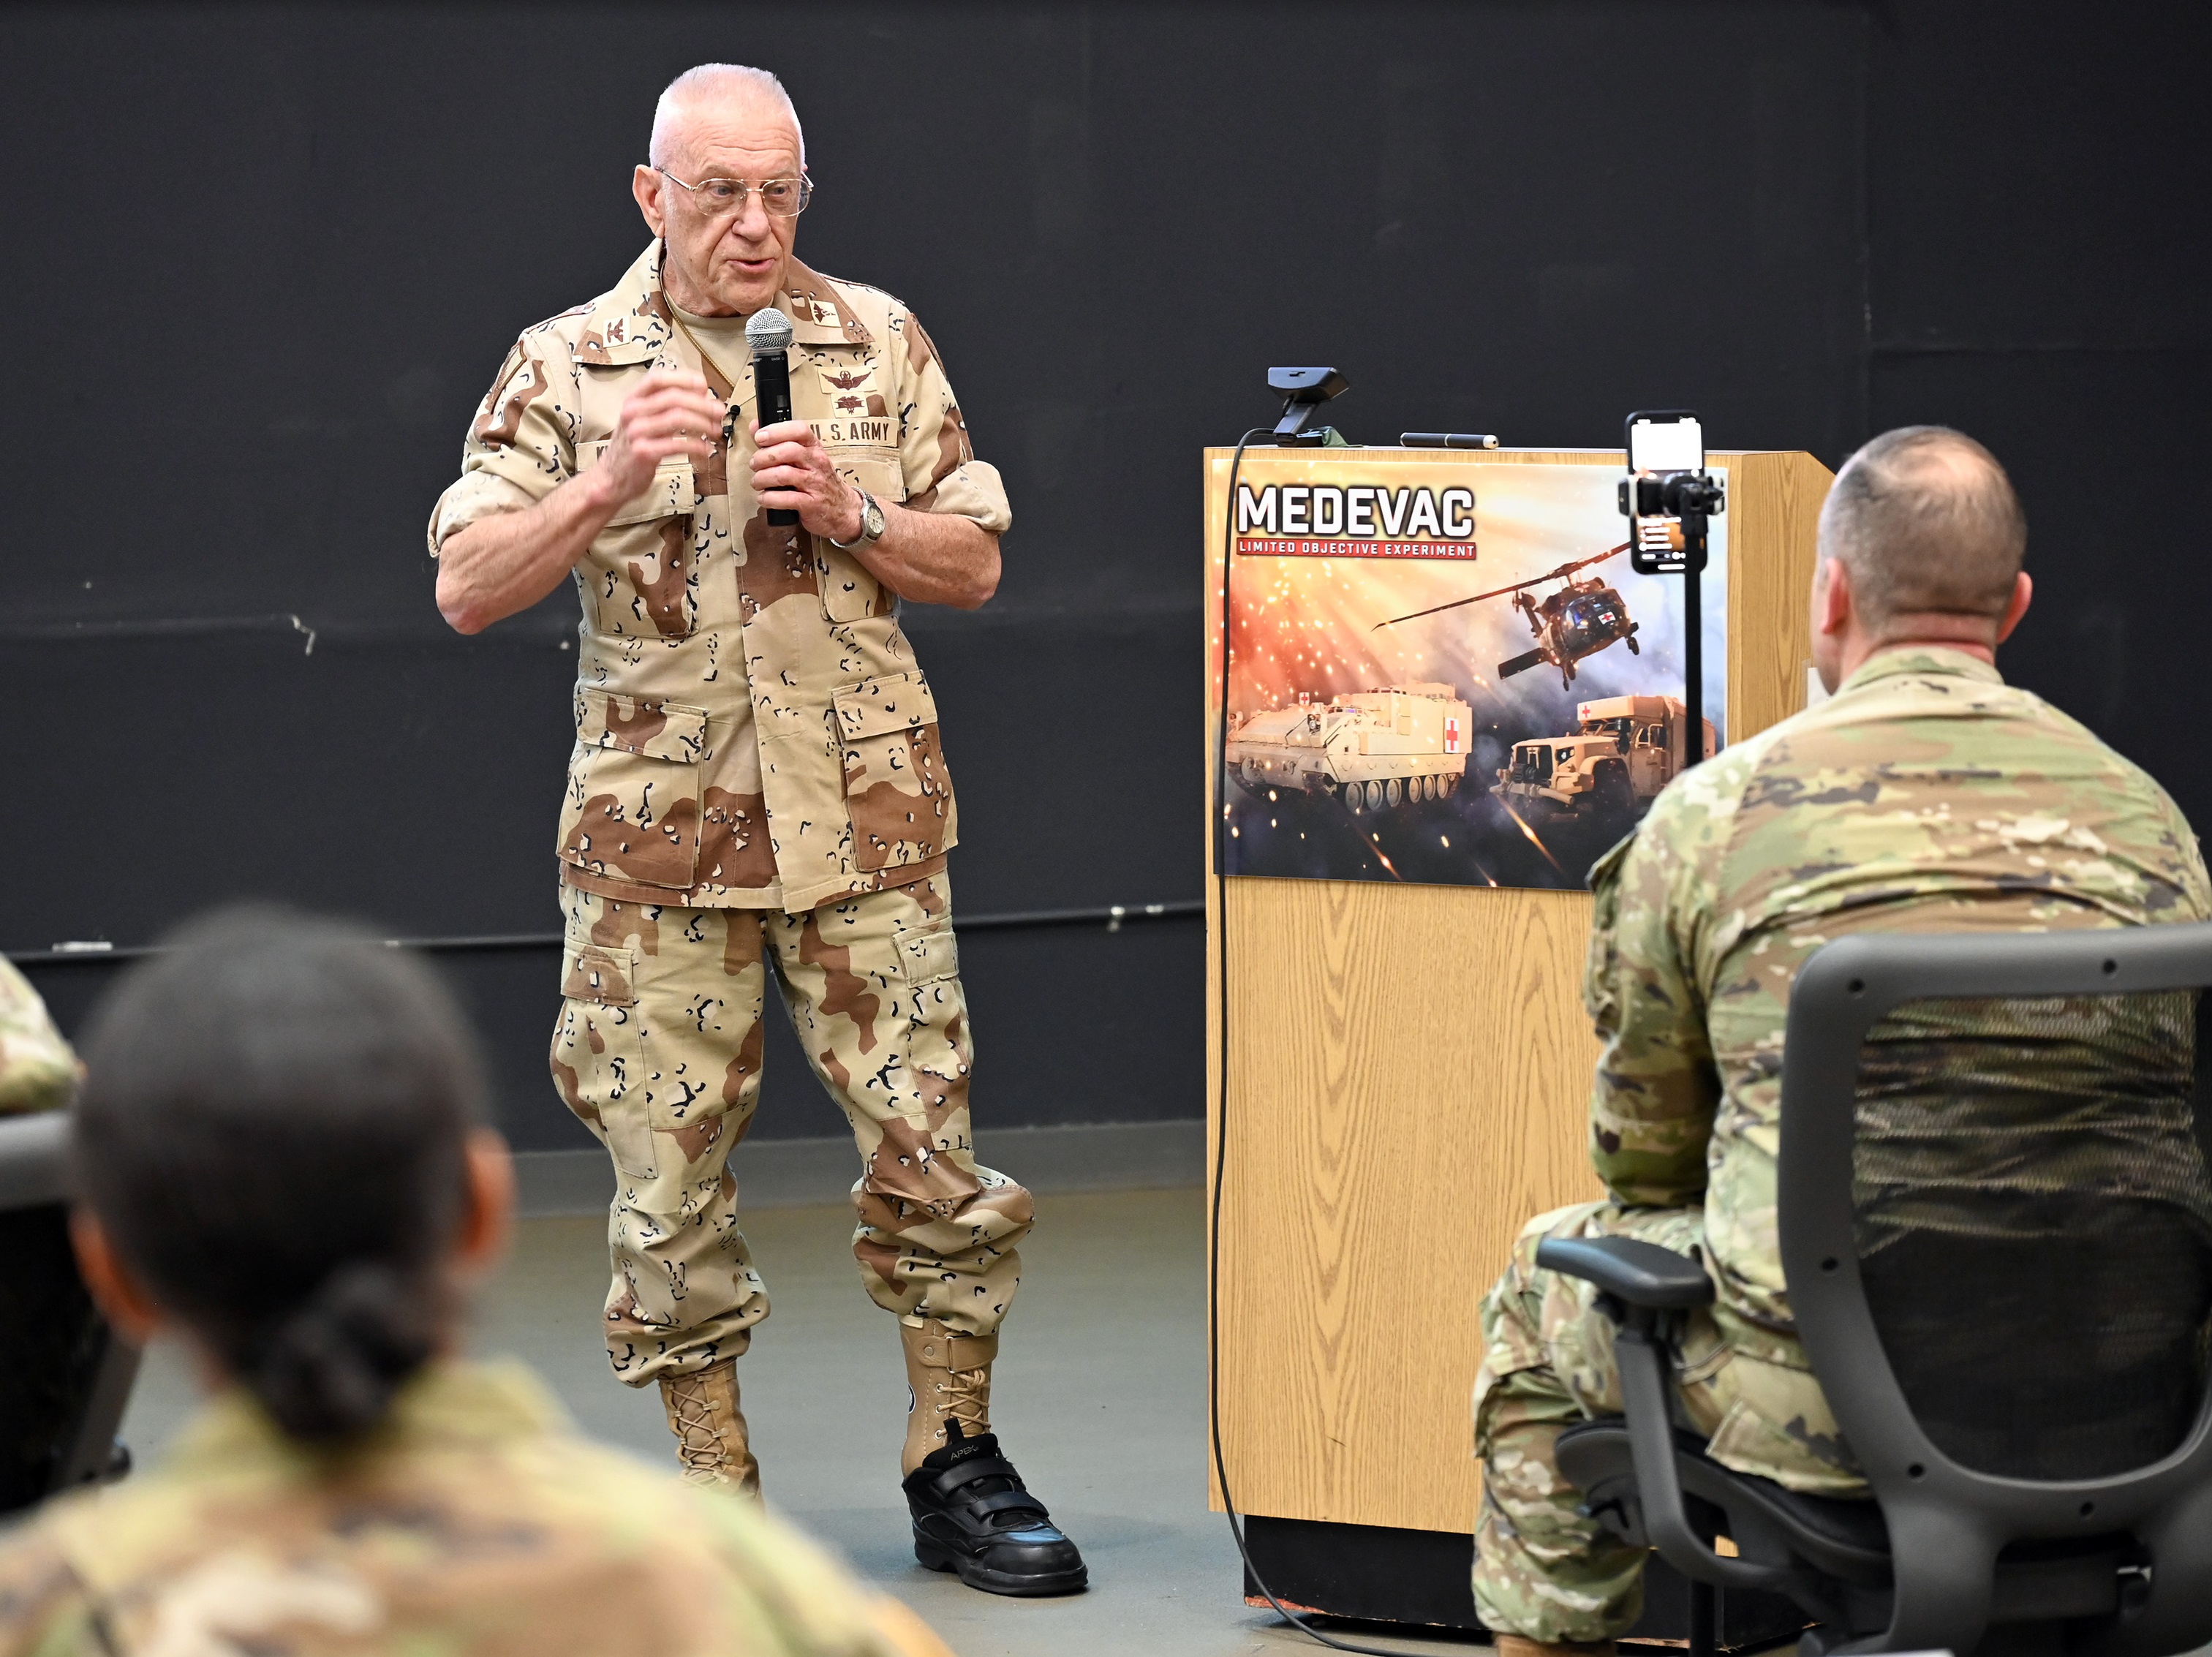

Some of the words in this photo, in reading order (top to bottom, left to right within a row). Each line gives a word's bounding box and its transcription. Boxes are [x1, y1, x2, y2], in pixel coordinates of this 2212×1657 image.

[830, 423, 846, 441] S.
[850, 422, 889, 441] ARMY
[1238, 486, 1473, 537] MEDEVAC
[1239, 541, 1296, 554] LIMITED
[1302, 542, 1378, 555] OBJECTIVE
[1384, 545, 1475, 557] EXPERIMENT
[951, 1444, 977, 1461] APEX
